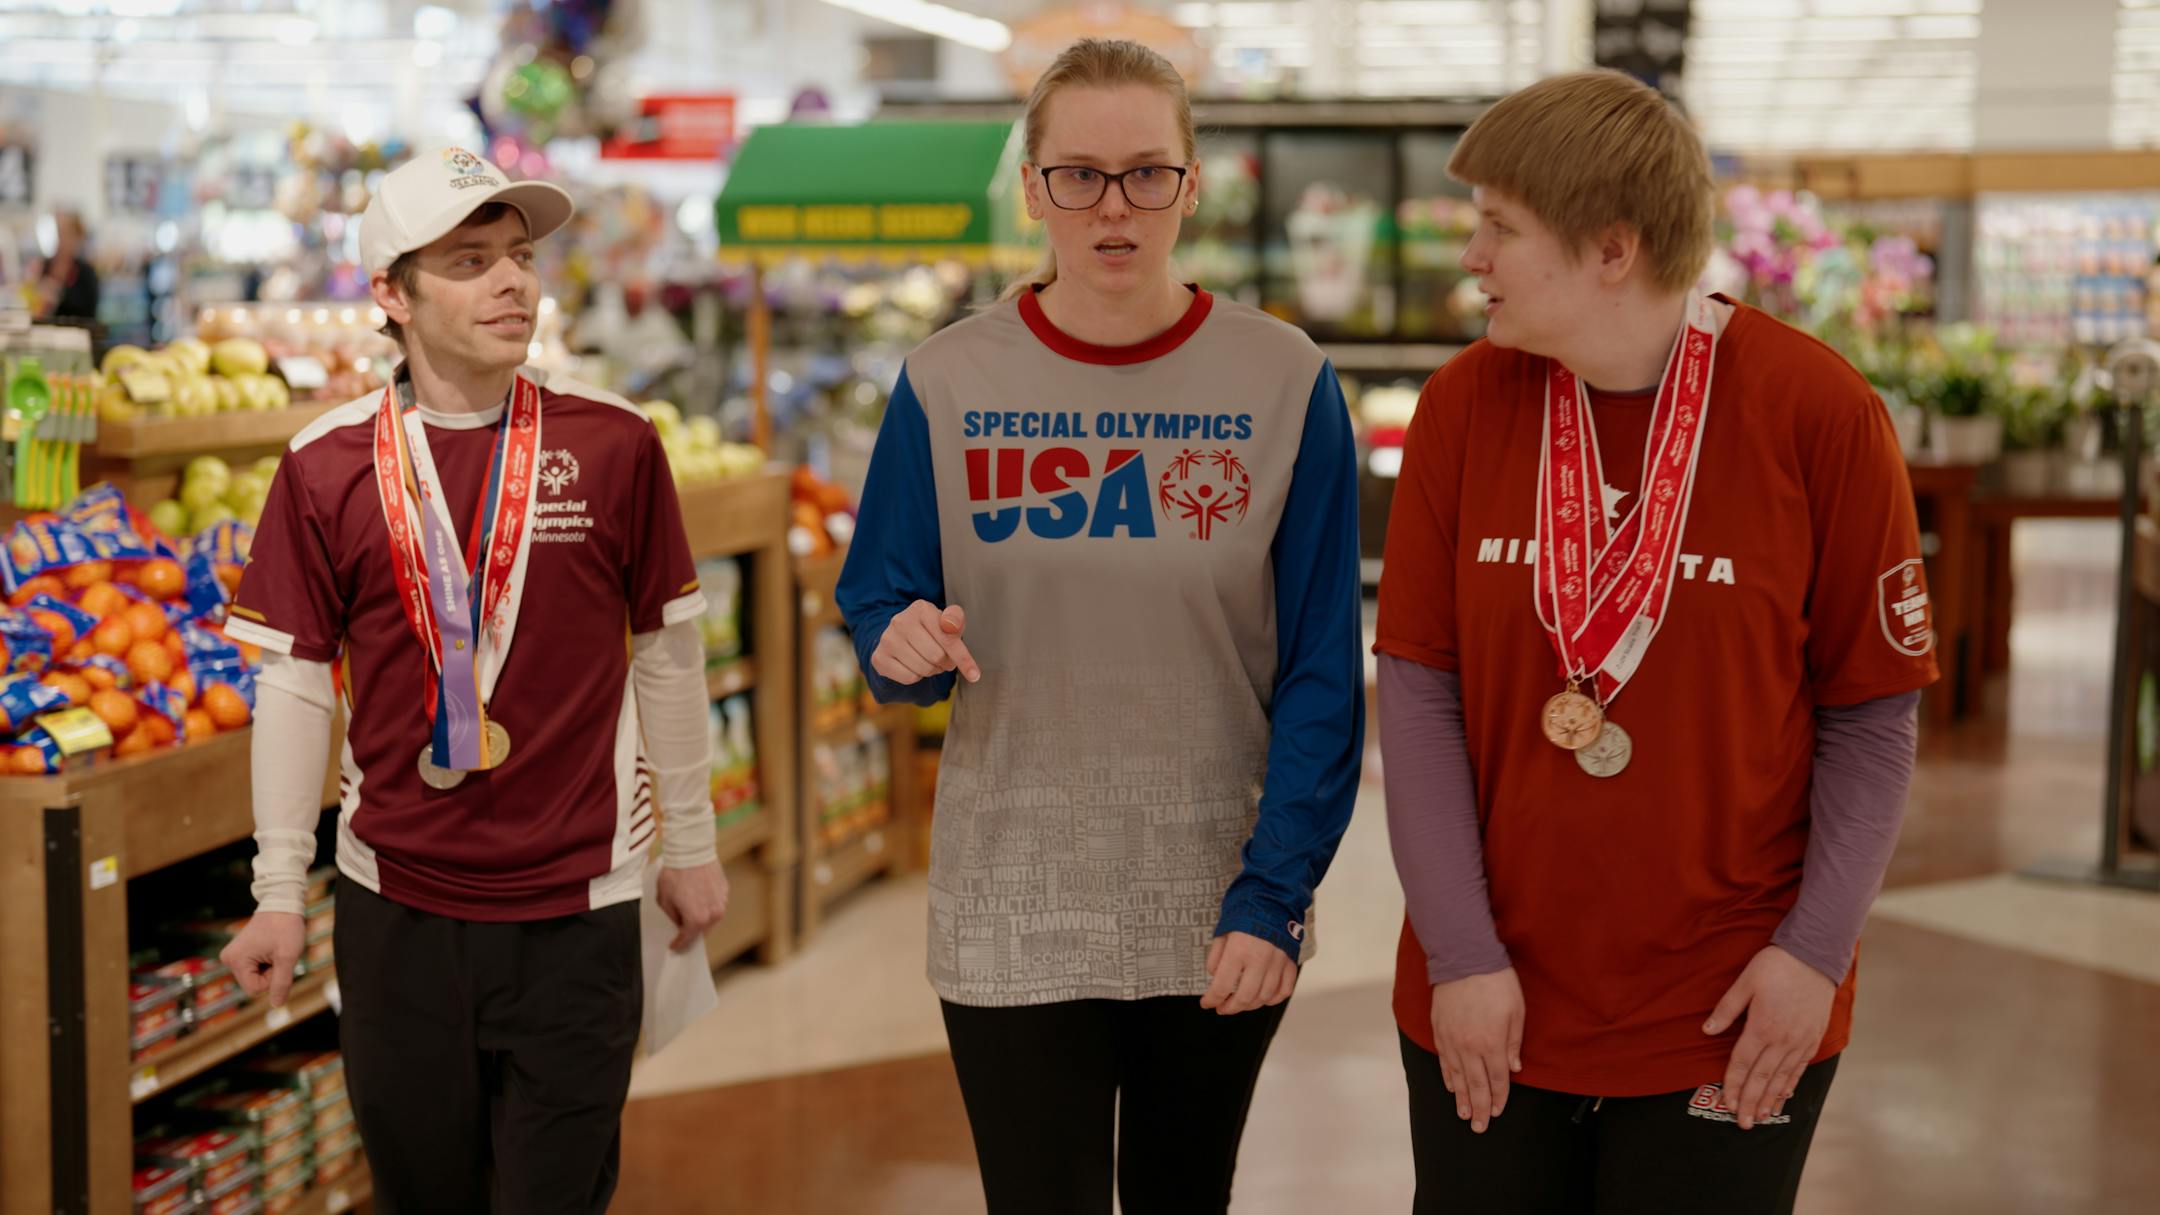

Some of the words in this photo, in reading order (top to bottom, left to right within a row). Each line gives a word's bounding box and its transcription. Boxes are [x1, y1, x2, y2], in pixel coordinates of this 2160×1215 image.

[963, 410, 1088, 439] SPECIAL
[1096, 412, 1253, 441] OLYMPICS
[965, 447, 1156, 543] USA
[531, 532, 586, 543] Minnesota
[443, 574, 457, 613] SHINE
[1124, 772, 1178, 786] RESPECT
[1086, 785, 1180, 807] CHARACTER
[1087, 818, 1125, 830] PRIDE
[984, 827, 1073, 844] CONFIDENCE
[992, 864, 1045, 883] HUSTLE
[992, 881, 1044, 896] RESPECT
[957, 894, 1046, 916] CHARACTER
[1112, 891, 1159, 912] SKILL
[1008, 910, 1120, 936] TEAMWORK
[958, 926, 996, 940] PRIDE
[1086, 931, 1120, 946] SPEED
[1122, 912, 1137, 987] DEDICATION
[1137, 937, 1175, 951] PRIDE
[1031, 950, 1120, 967] CONFIDENCE
[1064, 961, 1091, 975] USA
[997, 975, 1091, 994] FUNDAMENTALS
[1140, 976, 1194, 992] RESPECT
[1028, 987, 1078, 1005] ABILITY
